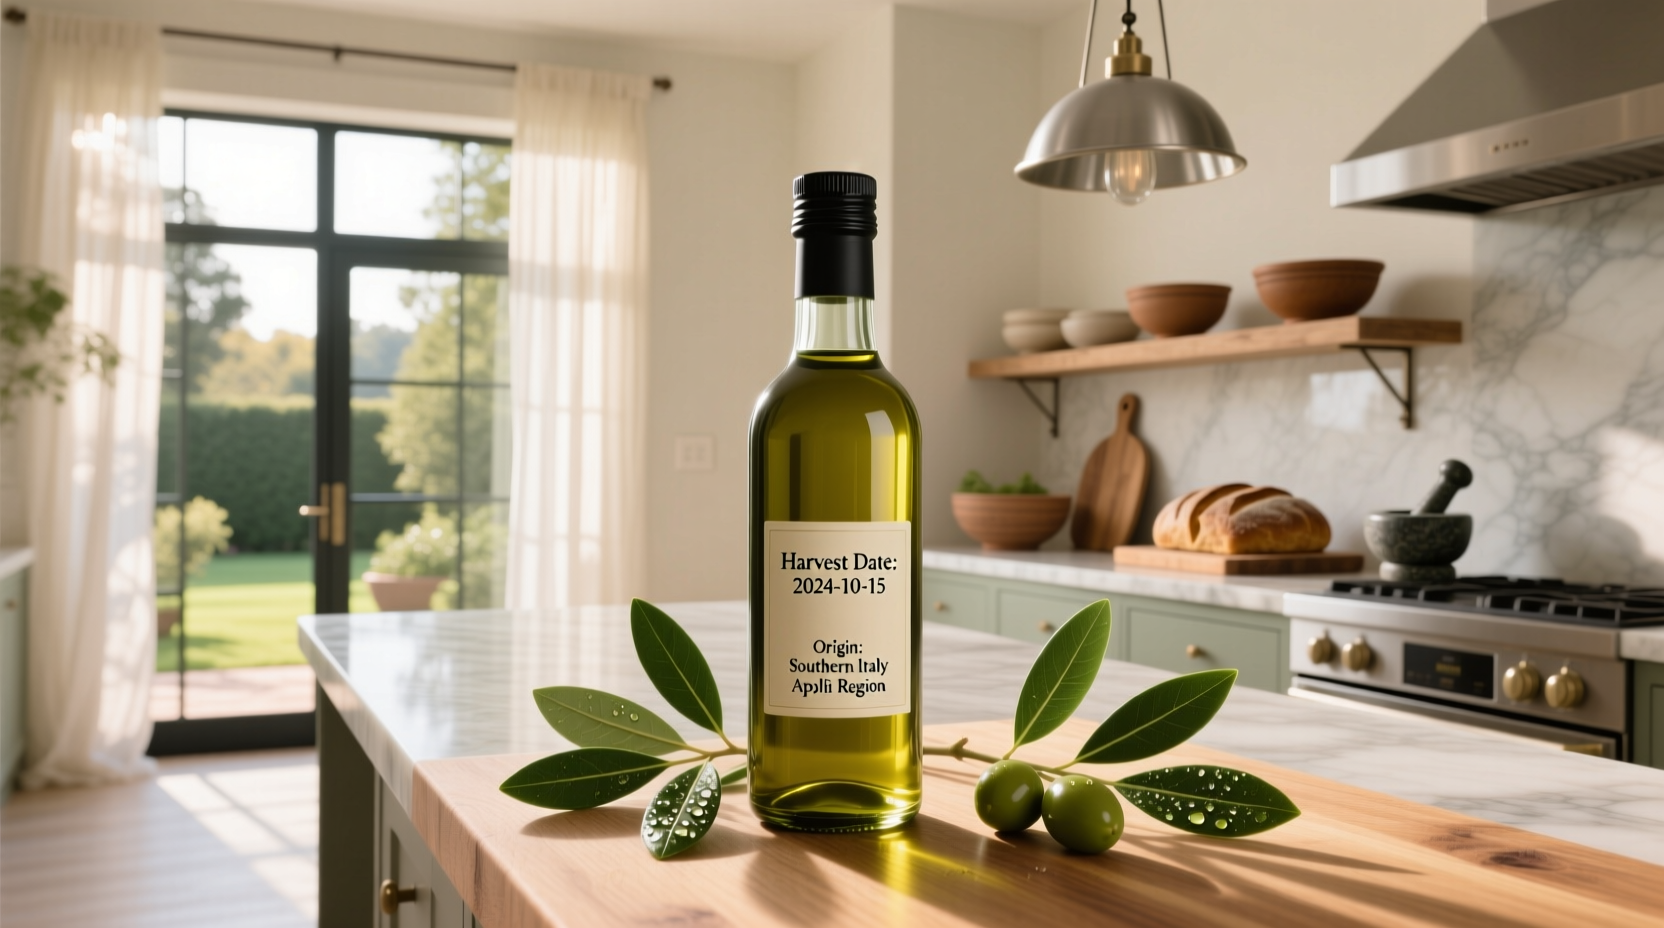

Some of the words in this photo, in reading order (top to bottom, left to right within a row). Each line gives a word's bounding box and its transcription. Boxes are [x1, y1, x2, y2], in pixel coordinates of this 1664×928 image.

[780, 551, 849, 571] Harvest
[853, 552, 897, 571] Date:
[792, 577, 886, 595] 2024-10-15
[813, 639, 863, 658] Origin:
[789, 657, 855, 674] Southern
[858, 657, 889, 676] Italy
[837, 678, 886, 698] Region
